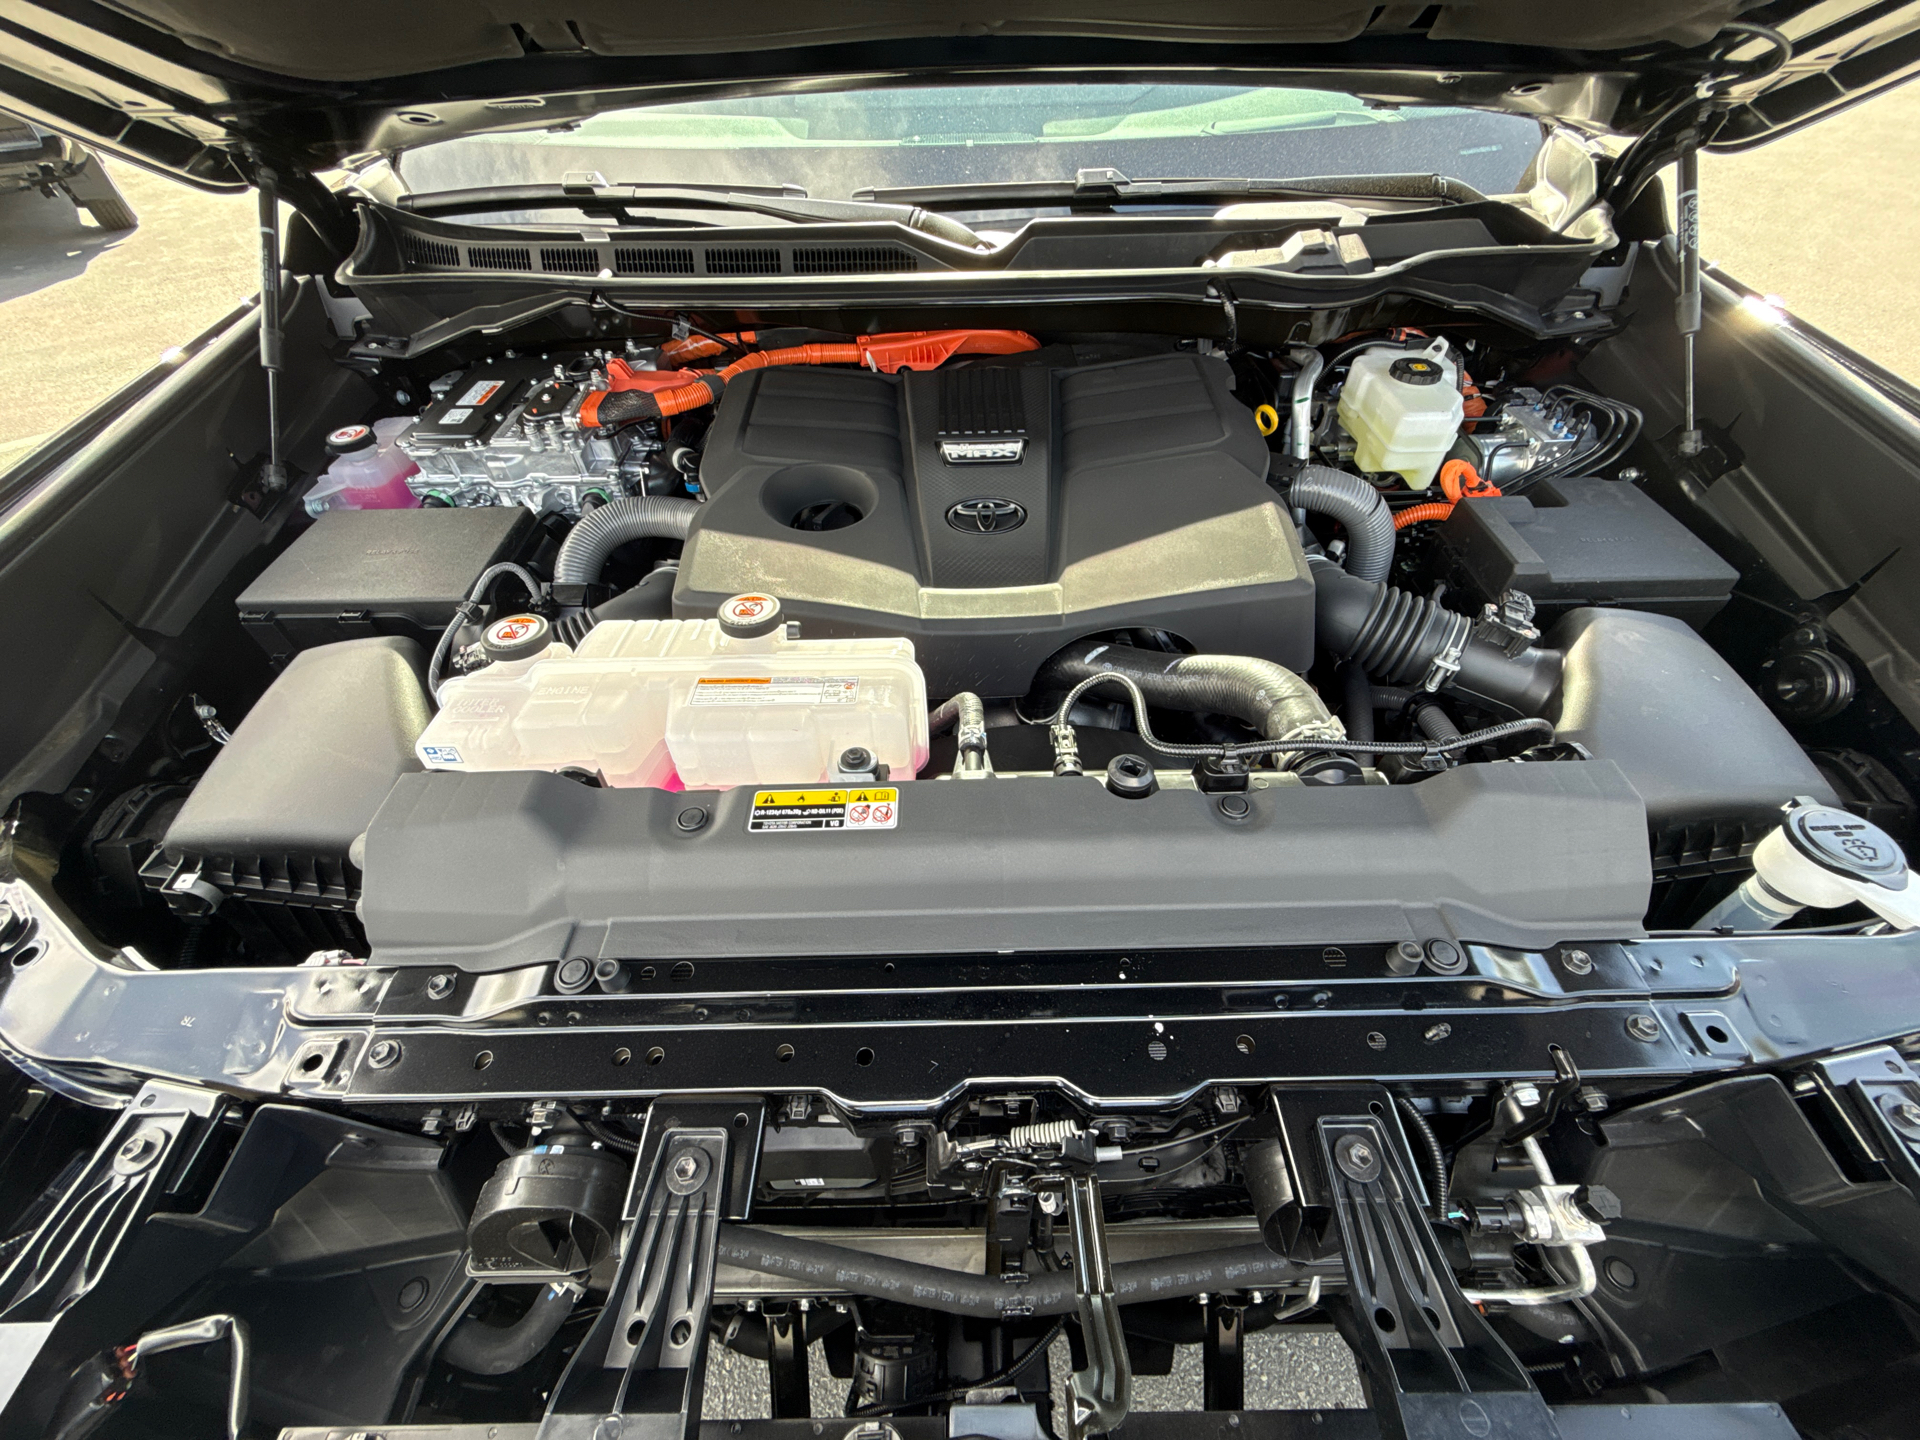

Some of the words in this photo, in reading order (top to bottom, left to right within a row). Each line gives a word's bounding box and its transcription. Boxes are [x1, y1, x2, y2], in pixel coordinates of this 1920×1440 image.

[947, 448, 1016, 458] MAX
[537, 685, 590, 696] ENGINE
[456, 698, 500, 707] INTER
[452, 704, 506, 714] COOLER
